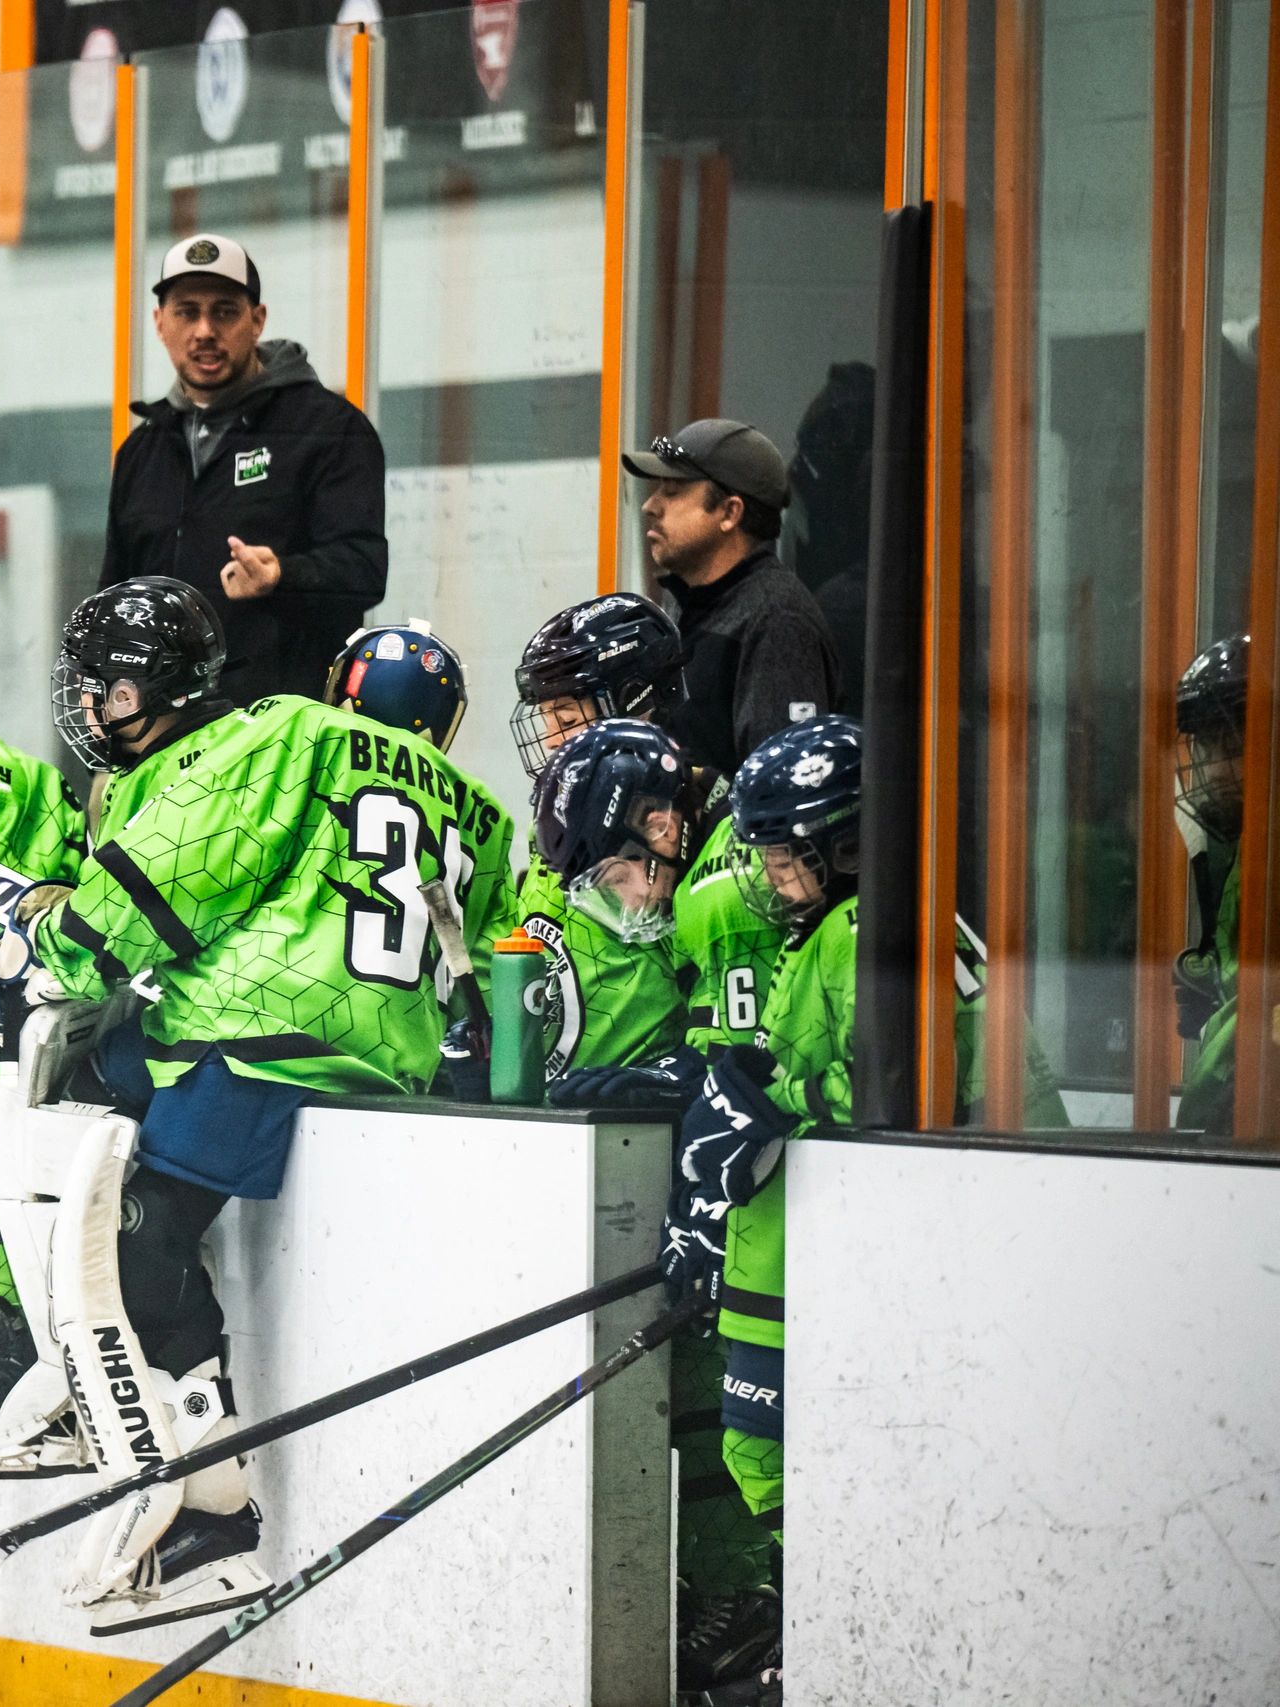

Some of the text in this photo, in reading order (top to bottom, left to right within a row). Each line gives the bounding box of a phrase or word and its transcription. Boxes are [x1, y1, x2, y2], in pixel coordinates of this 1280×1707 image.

[110, 652, 148, 665] CCM
[598, 640, 639, 661] BAUER
[603, 784, 623, 828] CCM
[680, 821, 690, 861] CCM
[648, 859, 657, 885] CCM
[545, 1048, 566, 1077] 2014
[710, 1270, 719, 1300] CCM
[92, 1325, 165, 1474] VAUGHN
[723, 1374, 778, 1406] UER
[224, 1544, 344, 1640] CCM
